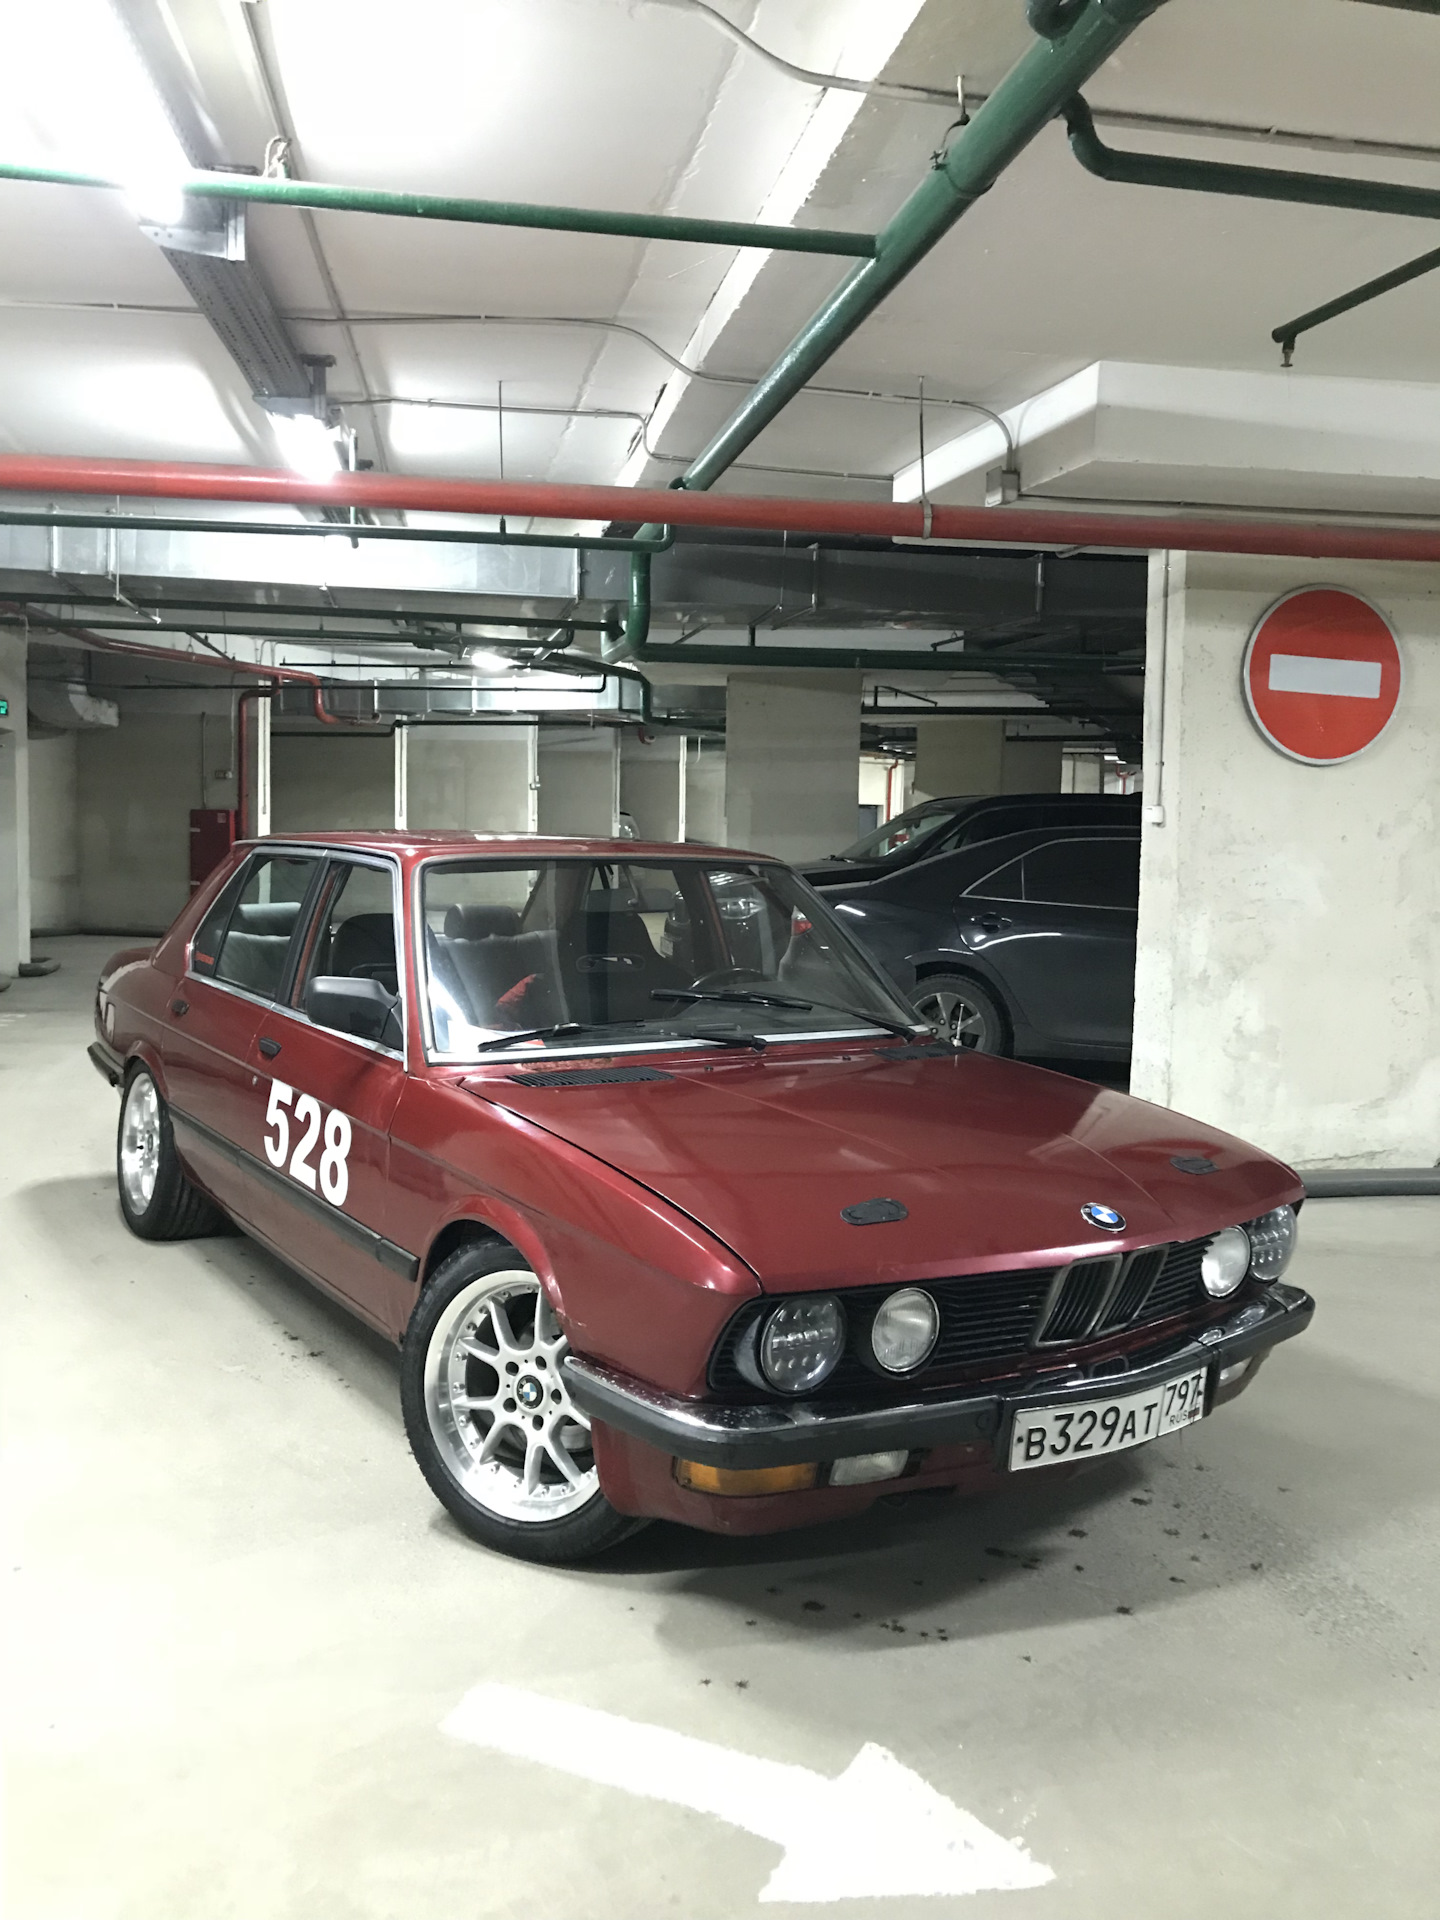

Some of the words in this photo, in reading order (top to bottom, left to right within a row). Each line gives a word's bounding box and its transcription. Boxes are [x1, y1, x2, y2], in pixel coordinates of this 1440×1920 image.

[263, 1077, 352, 1207] 528
[1166, 1373, 1202, 1416] 797
[1169, 1410, 1188, 1426] RUS
